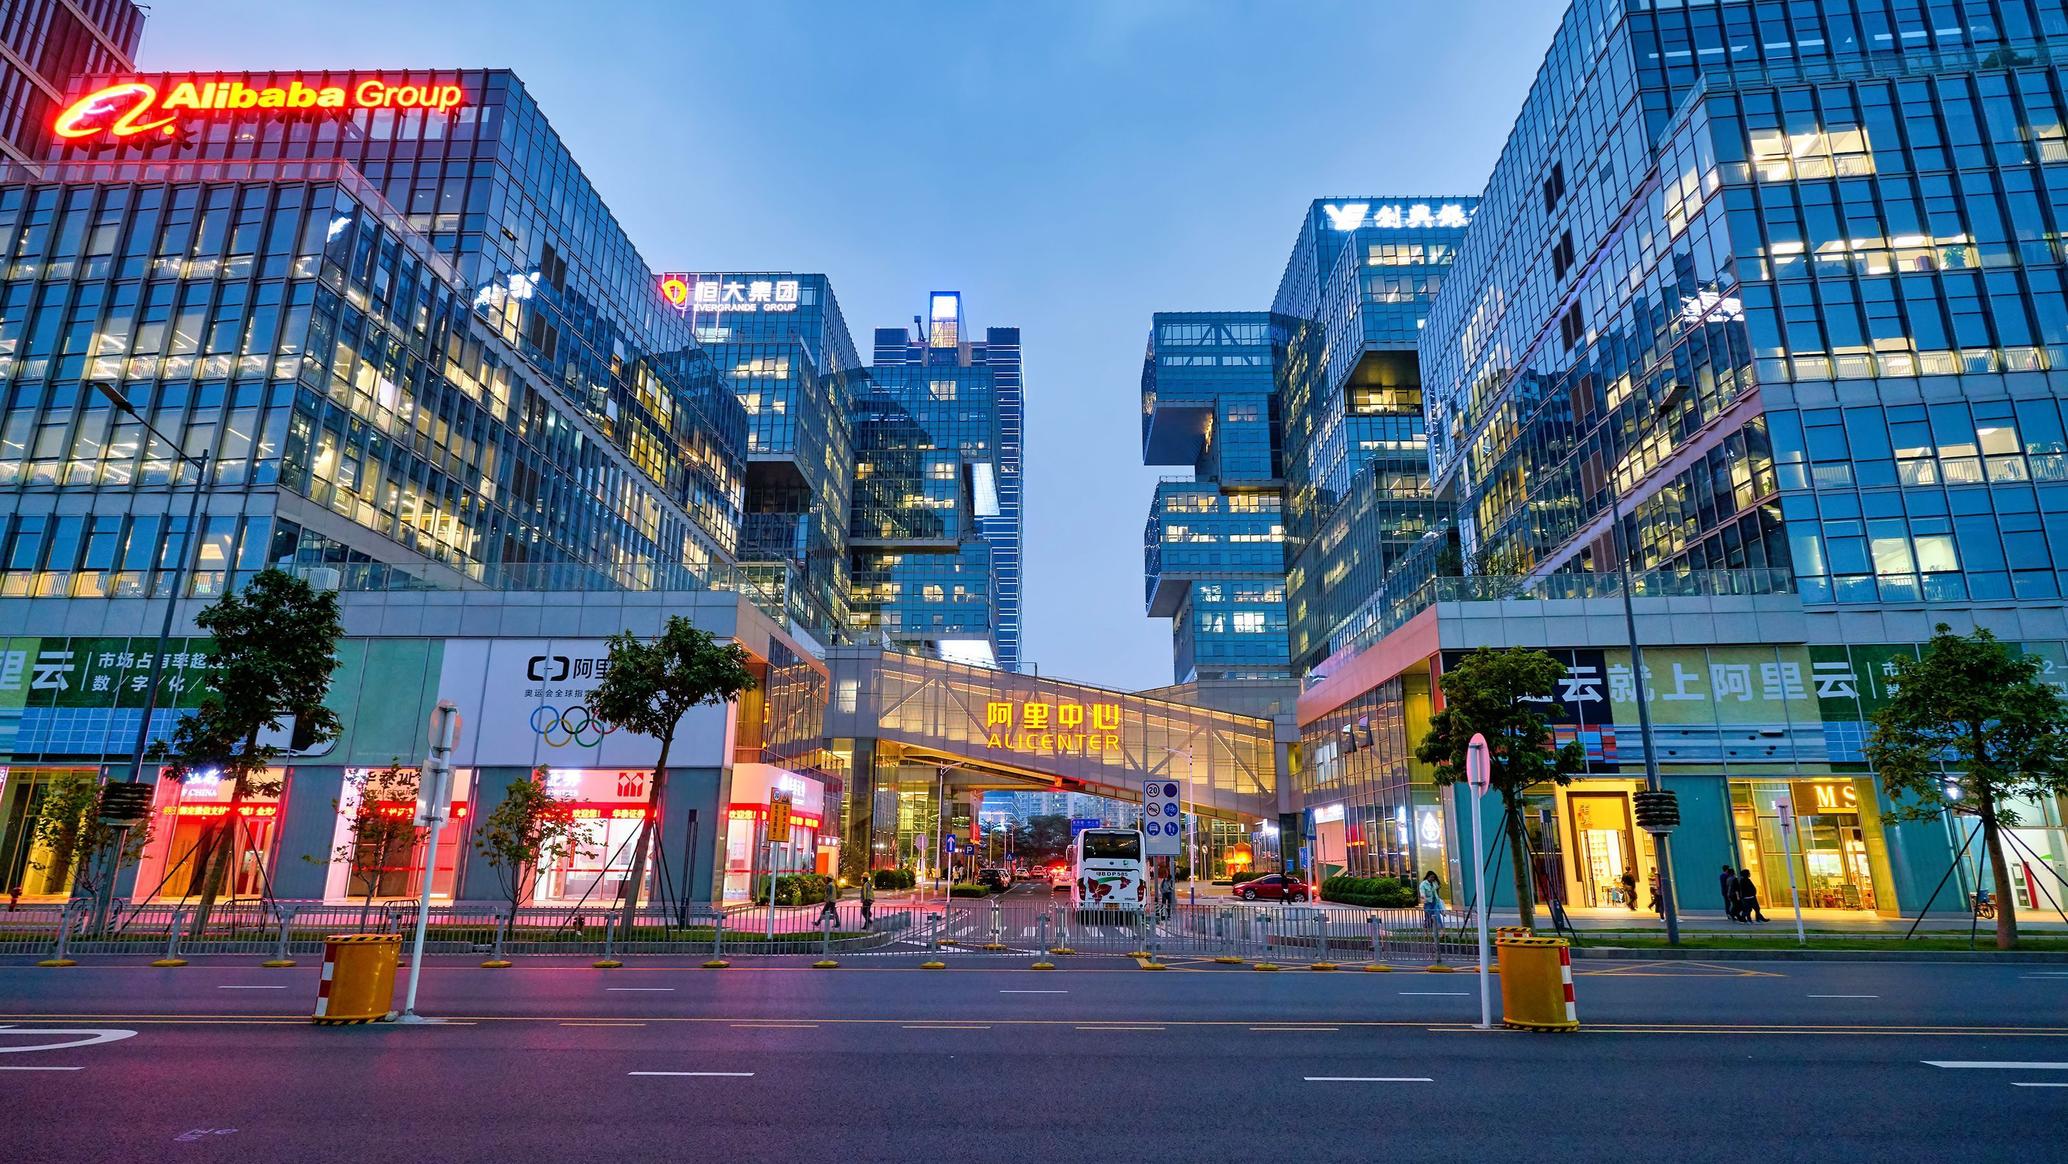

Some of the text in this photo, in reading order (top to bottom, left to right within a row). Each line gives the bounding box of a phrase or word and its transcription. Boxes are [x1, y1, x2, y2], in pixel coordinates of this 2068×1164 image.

[162, 80, 462, 113] Alibaba Group
[694, 281, 798, 302] 恒大集团
[693, 303, 797, 312] EVERGRANDE GROUP
[987, 702, 1119, 730] 阿里中心
[986, 734, 1119, 750] ALICENTER
[1148, 786, 1158, 795] 20
[966, 846, 973, 854] P
